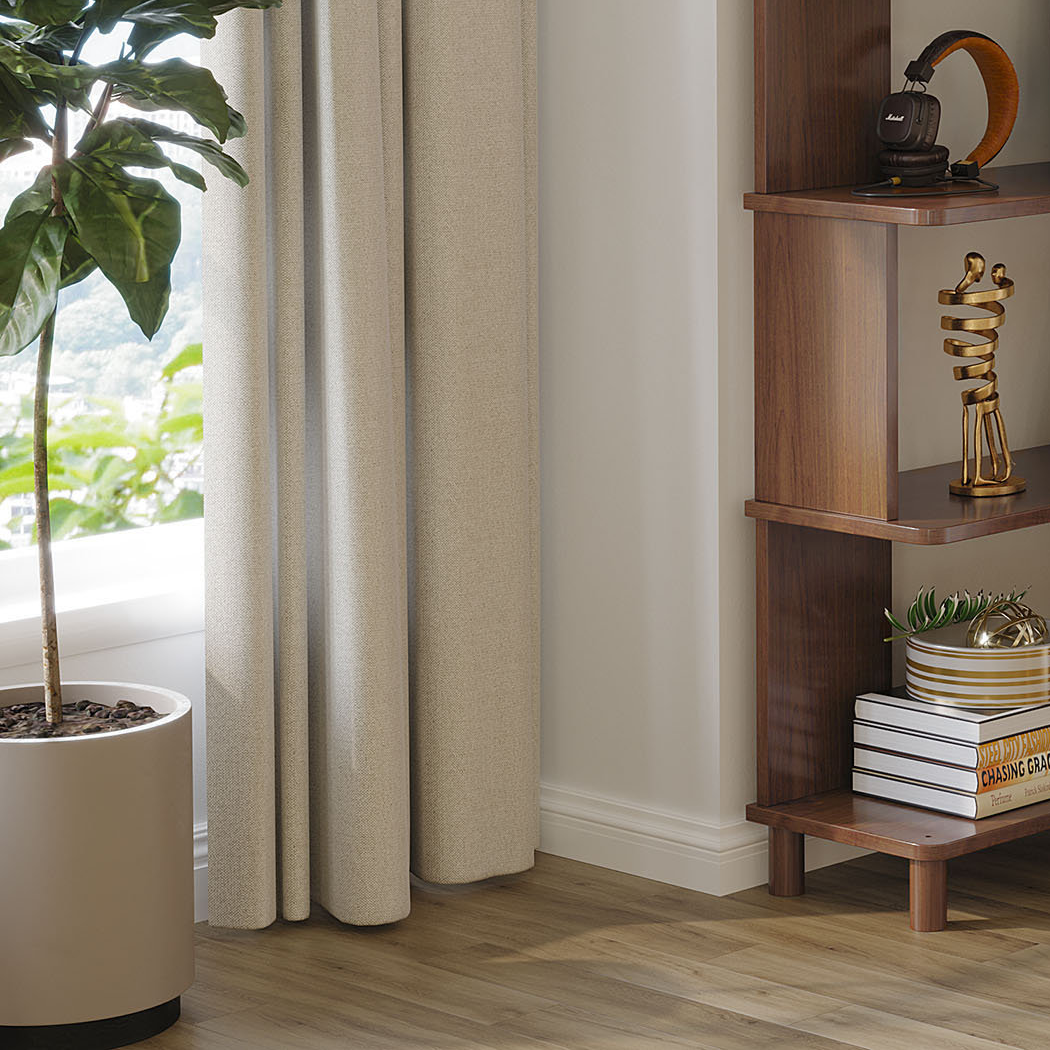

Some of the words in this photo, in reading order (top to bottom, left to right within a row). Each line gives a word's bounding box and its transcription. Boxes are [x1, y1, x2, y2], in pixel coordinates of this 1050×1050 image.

[978, 744, 1001, 768] STEEL
[1003, 737, 1020, 760] CITY
[981, 760, 1025, 787] CHASING
[990, 792, 1013, 807] Perfume
